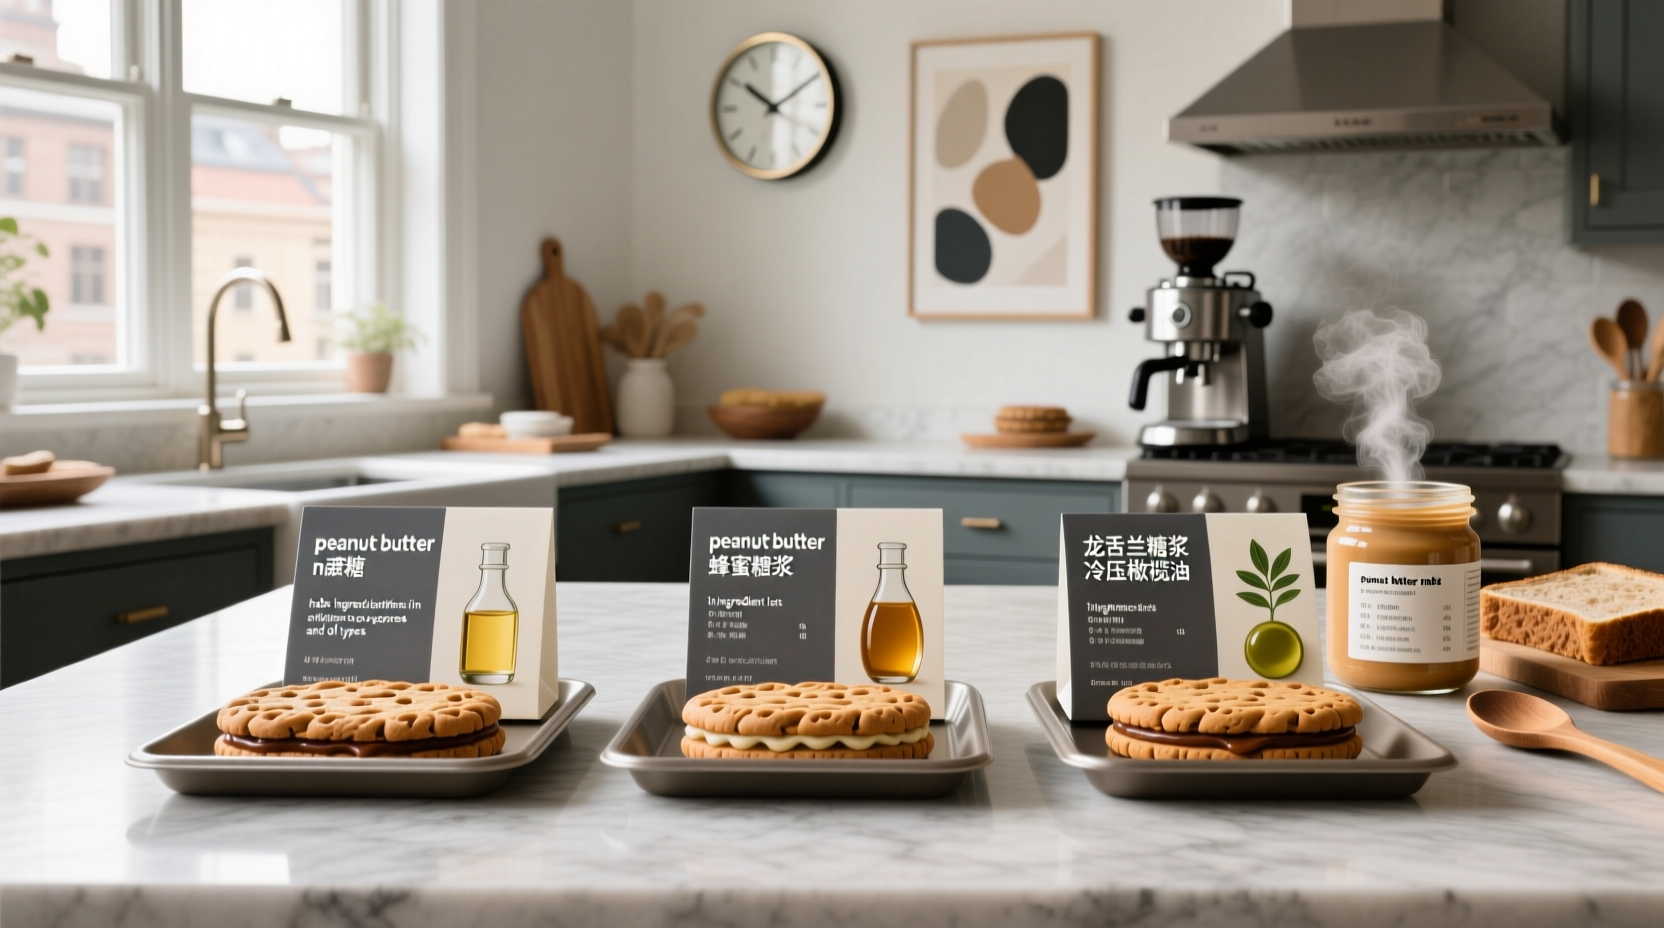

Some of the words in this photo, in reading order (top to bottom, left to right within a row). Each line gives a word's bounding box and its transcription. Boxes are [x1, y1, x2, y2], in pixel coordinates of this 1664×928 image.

[314, 535, 378, 555] peanut
[380, 533, 436, 552] butter
[709, 533, 770, 554] peanut
[772, 532, 826, 550] butter
[1082, 534, 1189, 558] 龙舌兰糖浆
[1083, 558, 1190, 582] 冷压橄榄油
